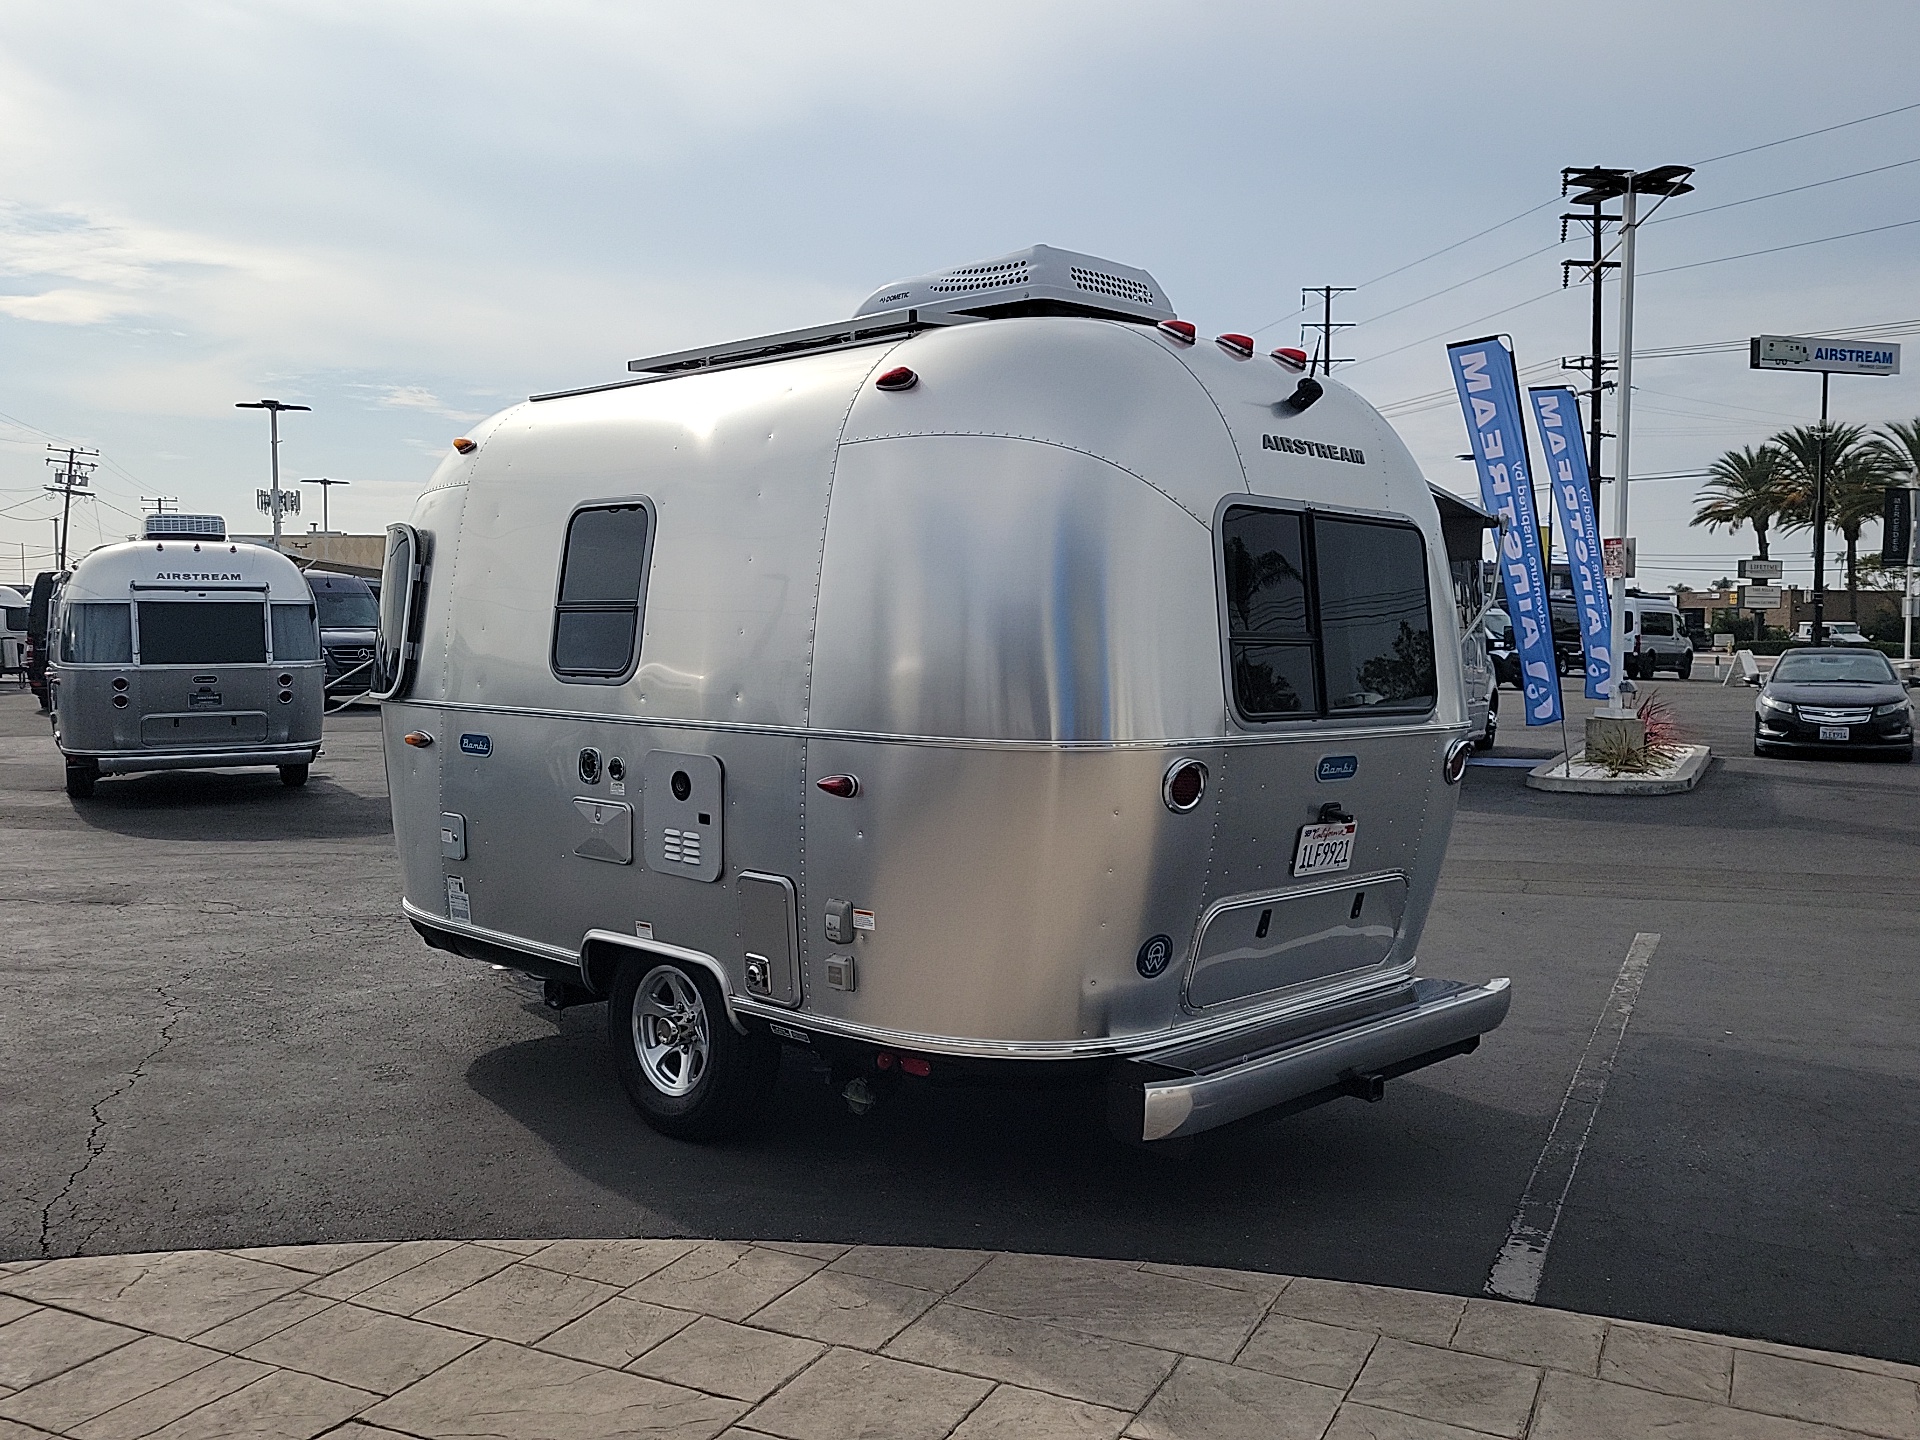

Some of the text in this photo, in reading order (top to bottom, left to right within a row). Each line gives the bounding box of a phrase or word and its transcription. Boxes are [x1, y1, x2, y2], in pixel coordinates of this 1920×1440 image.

[886, 291, 910, 303] DOMETIC
[1814, 347, 1893, 365] AIRSTREAM
[1262, 434, 1366, 465] AIRSTREAM
[1892, 497, 1901, 553] MERCEDES
[156, 572, 242, 581] AIRSTREAM
[462, 738, 488, 750] Bambi
[1321, 763, 1354, 774] Bambi
[1299, 839, 1350, 869] 1LF9921
